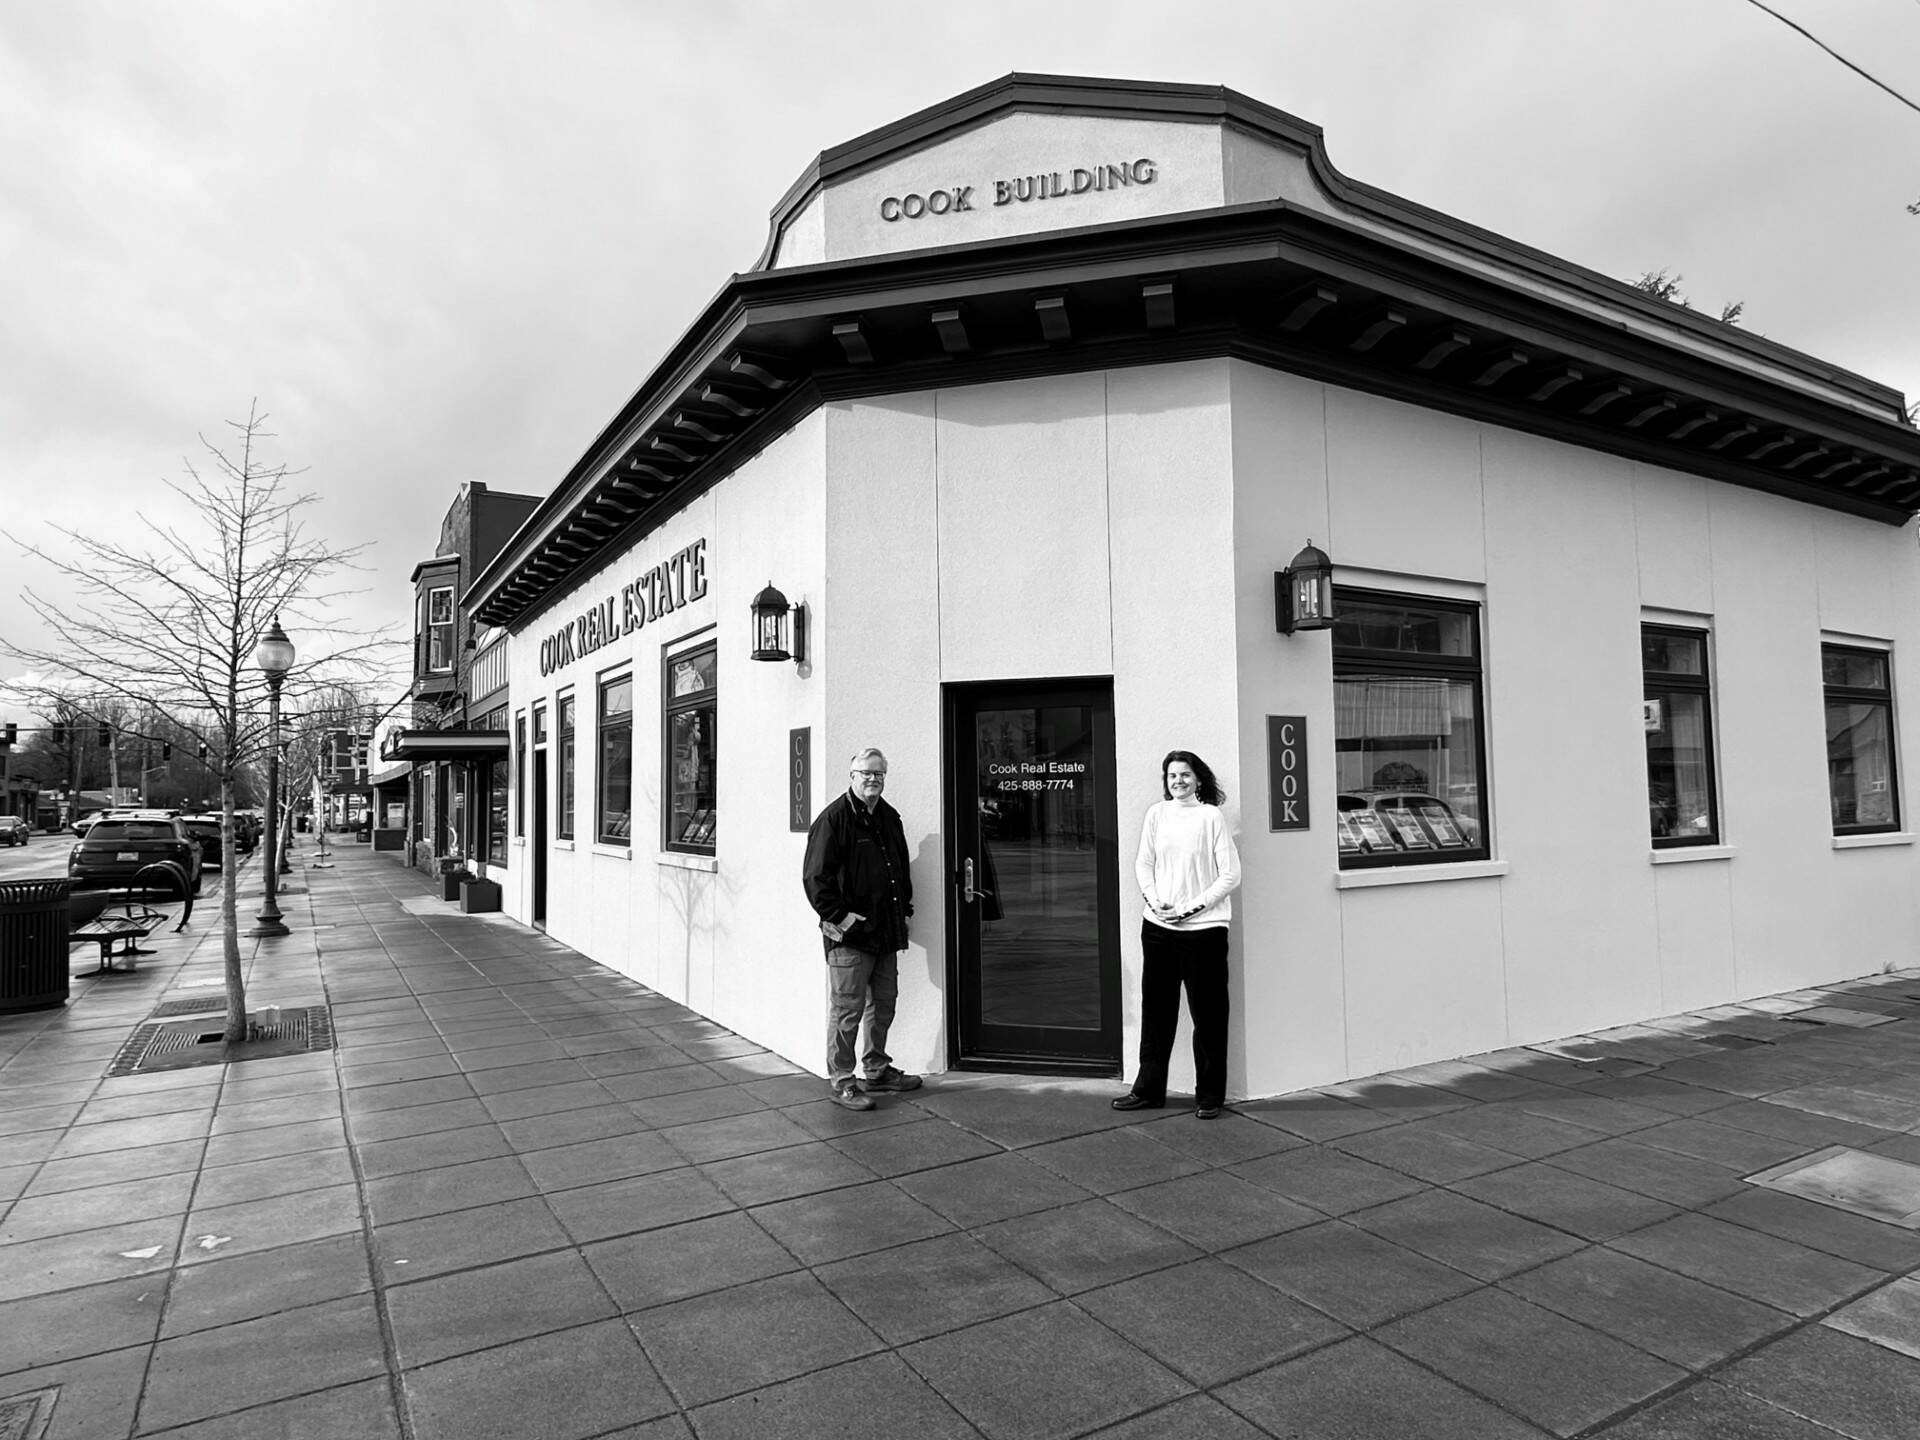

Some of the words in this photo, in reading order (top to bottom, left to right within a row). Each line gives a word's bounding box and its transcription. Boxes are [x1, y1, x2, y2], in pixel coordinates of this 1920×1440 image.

[880, 186, 974, 222] COOK
[992, 158, 1157, 206] BUILDING
[540, 621, 575, 678] COOK
[576, 595, 620, 659] REAL
[621, 537, 708, 636] ESTATE
[795, 735, 804, 825] COOK
[989, 763, 1018, 774] Cook
[1021, 762, 1046, 773] Real
[1049, 761, 1085, 773] Estate
[998, 779, 1074, 791] 425-888-7774
[1280, 723, 1299, 822] COOK
